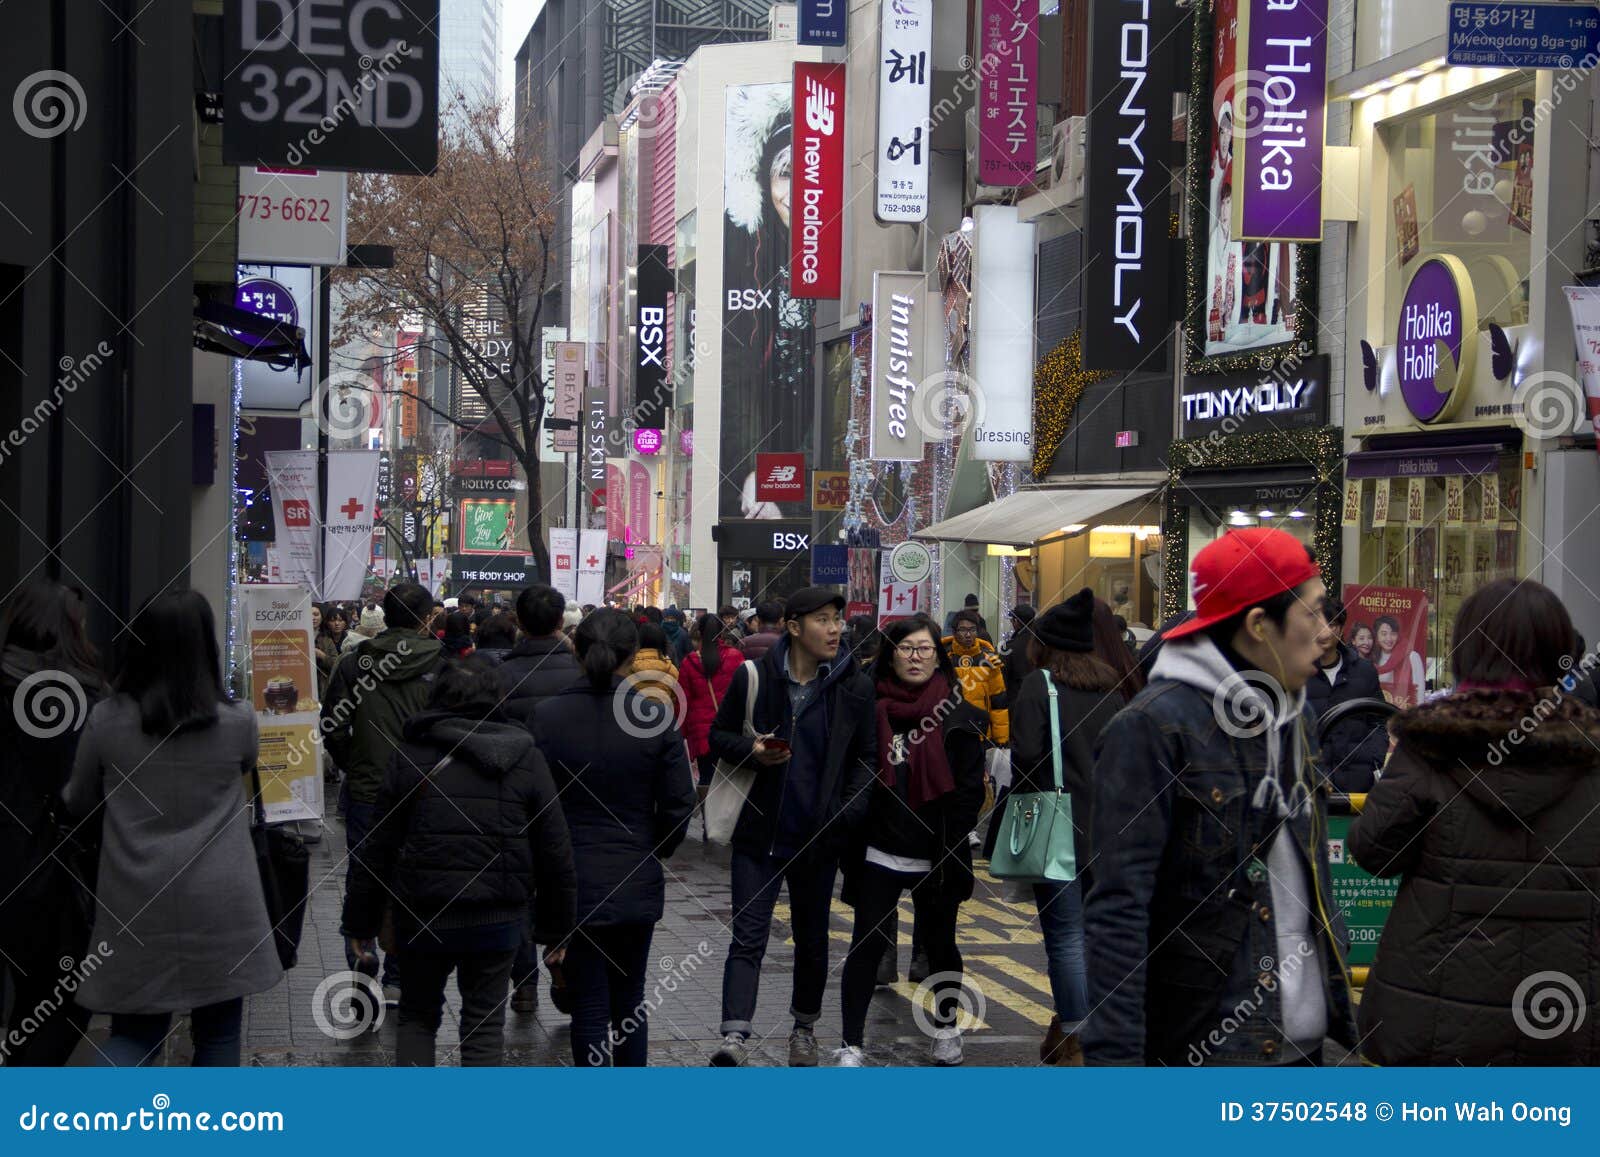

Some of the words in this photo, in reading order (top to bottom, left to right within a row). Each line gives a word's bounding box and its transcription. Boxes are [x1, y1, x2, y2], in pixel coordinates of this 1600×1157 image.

[240, 0, 423, 59] DEC.
[1454, 7, 1536, 30] 명동8가길
[1453, 32, 1538, 49] Myeongdong
[1541, 35, 1587, 50] 8ga-gil
[240, 64, 423, 129] 32ND
[987, 108, 1000, 119] 3F
[1261, 36, 1311, 191] Holika
[804, 137, 821, 185] new
[237, 195, 330, 222] 773-6622
[883, 203, 921, 214] 752-0368
[803, 188, 823, 284] balance
[728, 289, 772, 311] BSX
[1405, 302, 1452, 341] Holika
[640, 307, 664, 366] BSX
[886, 293, 916, 440] innisfree
[1182, 379, 1303, 421] TONYMOLY
[637, 437, 659, 445] ETUDE
[975, 427, 1031, 444] Dressing
[591, 434, 605, 479] SKIN
[287, 507, 307, 520] SR
[474, 506, 494, 525] Give
[472, 524, 492, 544] Joy
[773, 533, 809, 550] BSX
[462, 571, 477, 579] THE
[480, 571, 502, 580] BODY
[503, 572, 526, 581] SHOP
[882, 584, 919, 611] 1+1
[1360, 596, 1387, 607] ADIEU
[1390, 599, 1411, 609] 2013
[255, 610, 303, 621] ESCARGOT
